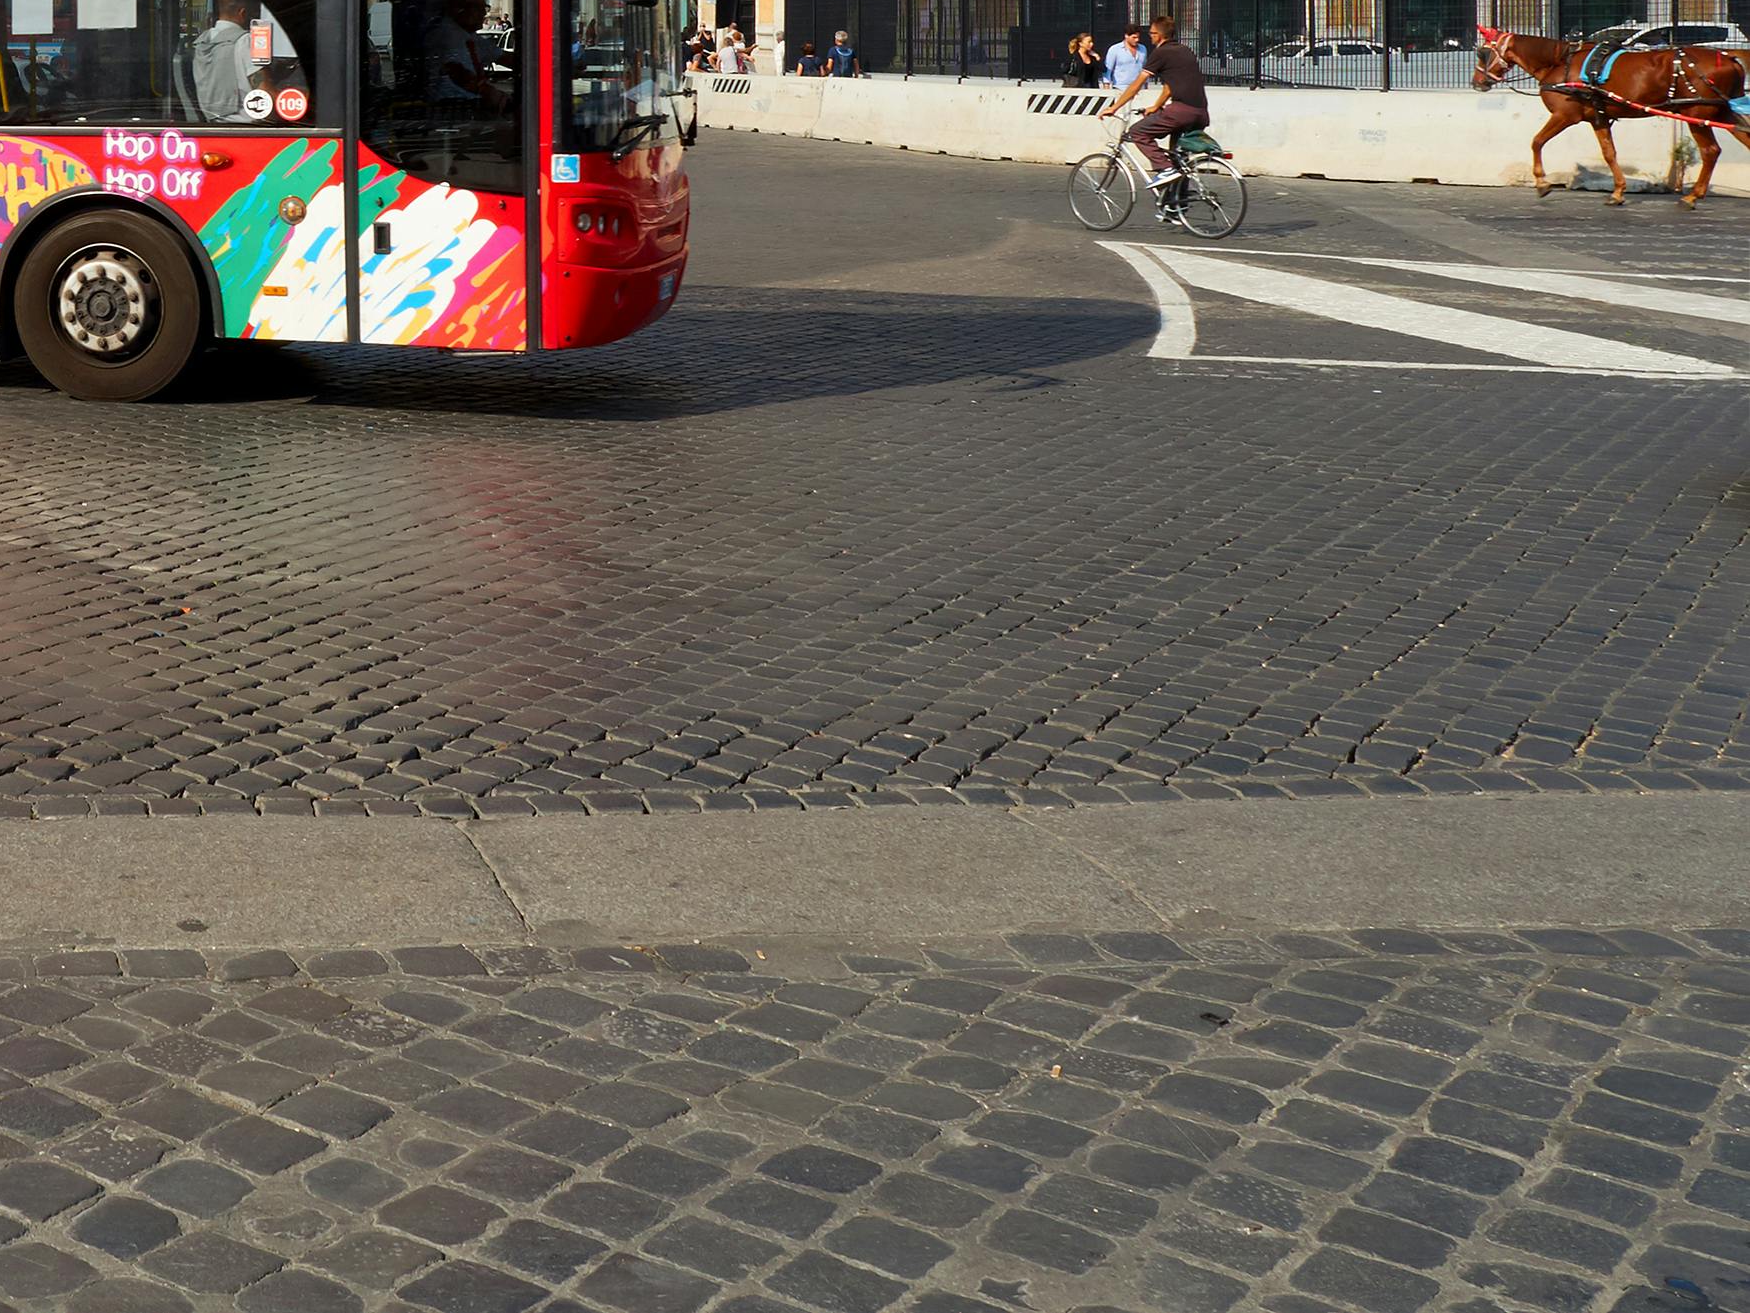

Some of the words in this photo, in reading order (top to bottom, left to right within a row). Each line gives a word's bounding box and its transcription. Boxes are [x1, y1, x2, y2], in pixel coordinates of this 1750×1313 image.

[279, 98, 303, 111] 109
[105, 132, 153, 161] Hop
[161, 130, 197, 160] On
[105, 169, 154, 198] Hop
[161, 168, 202, 197] Off
